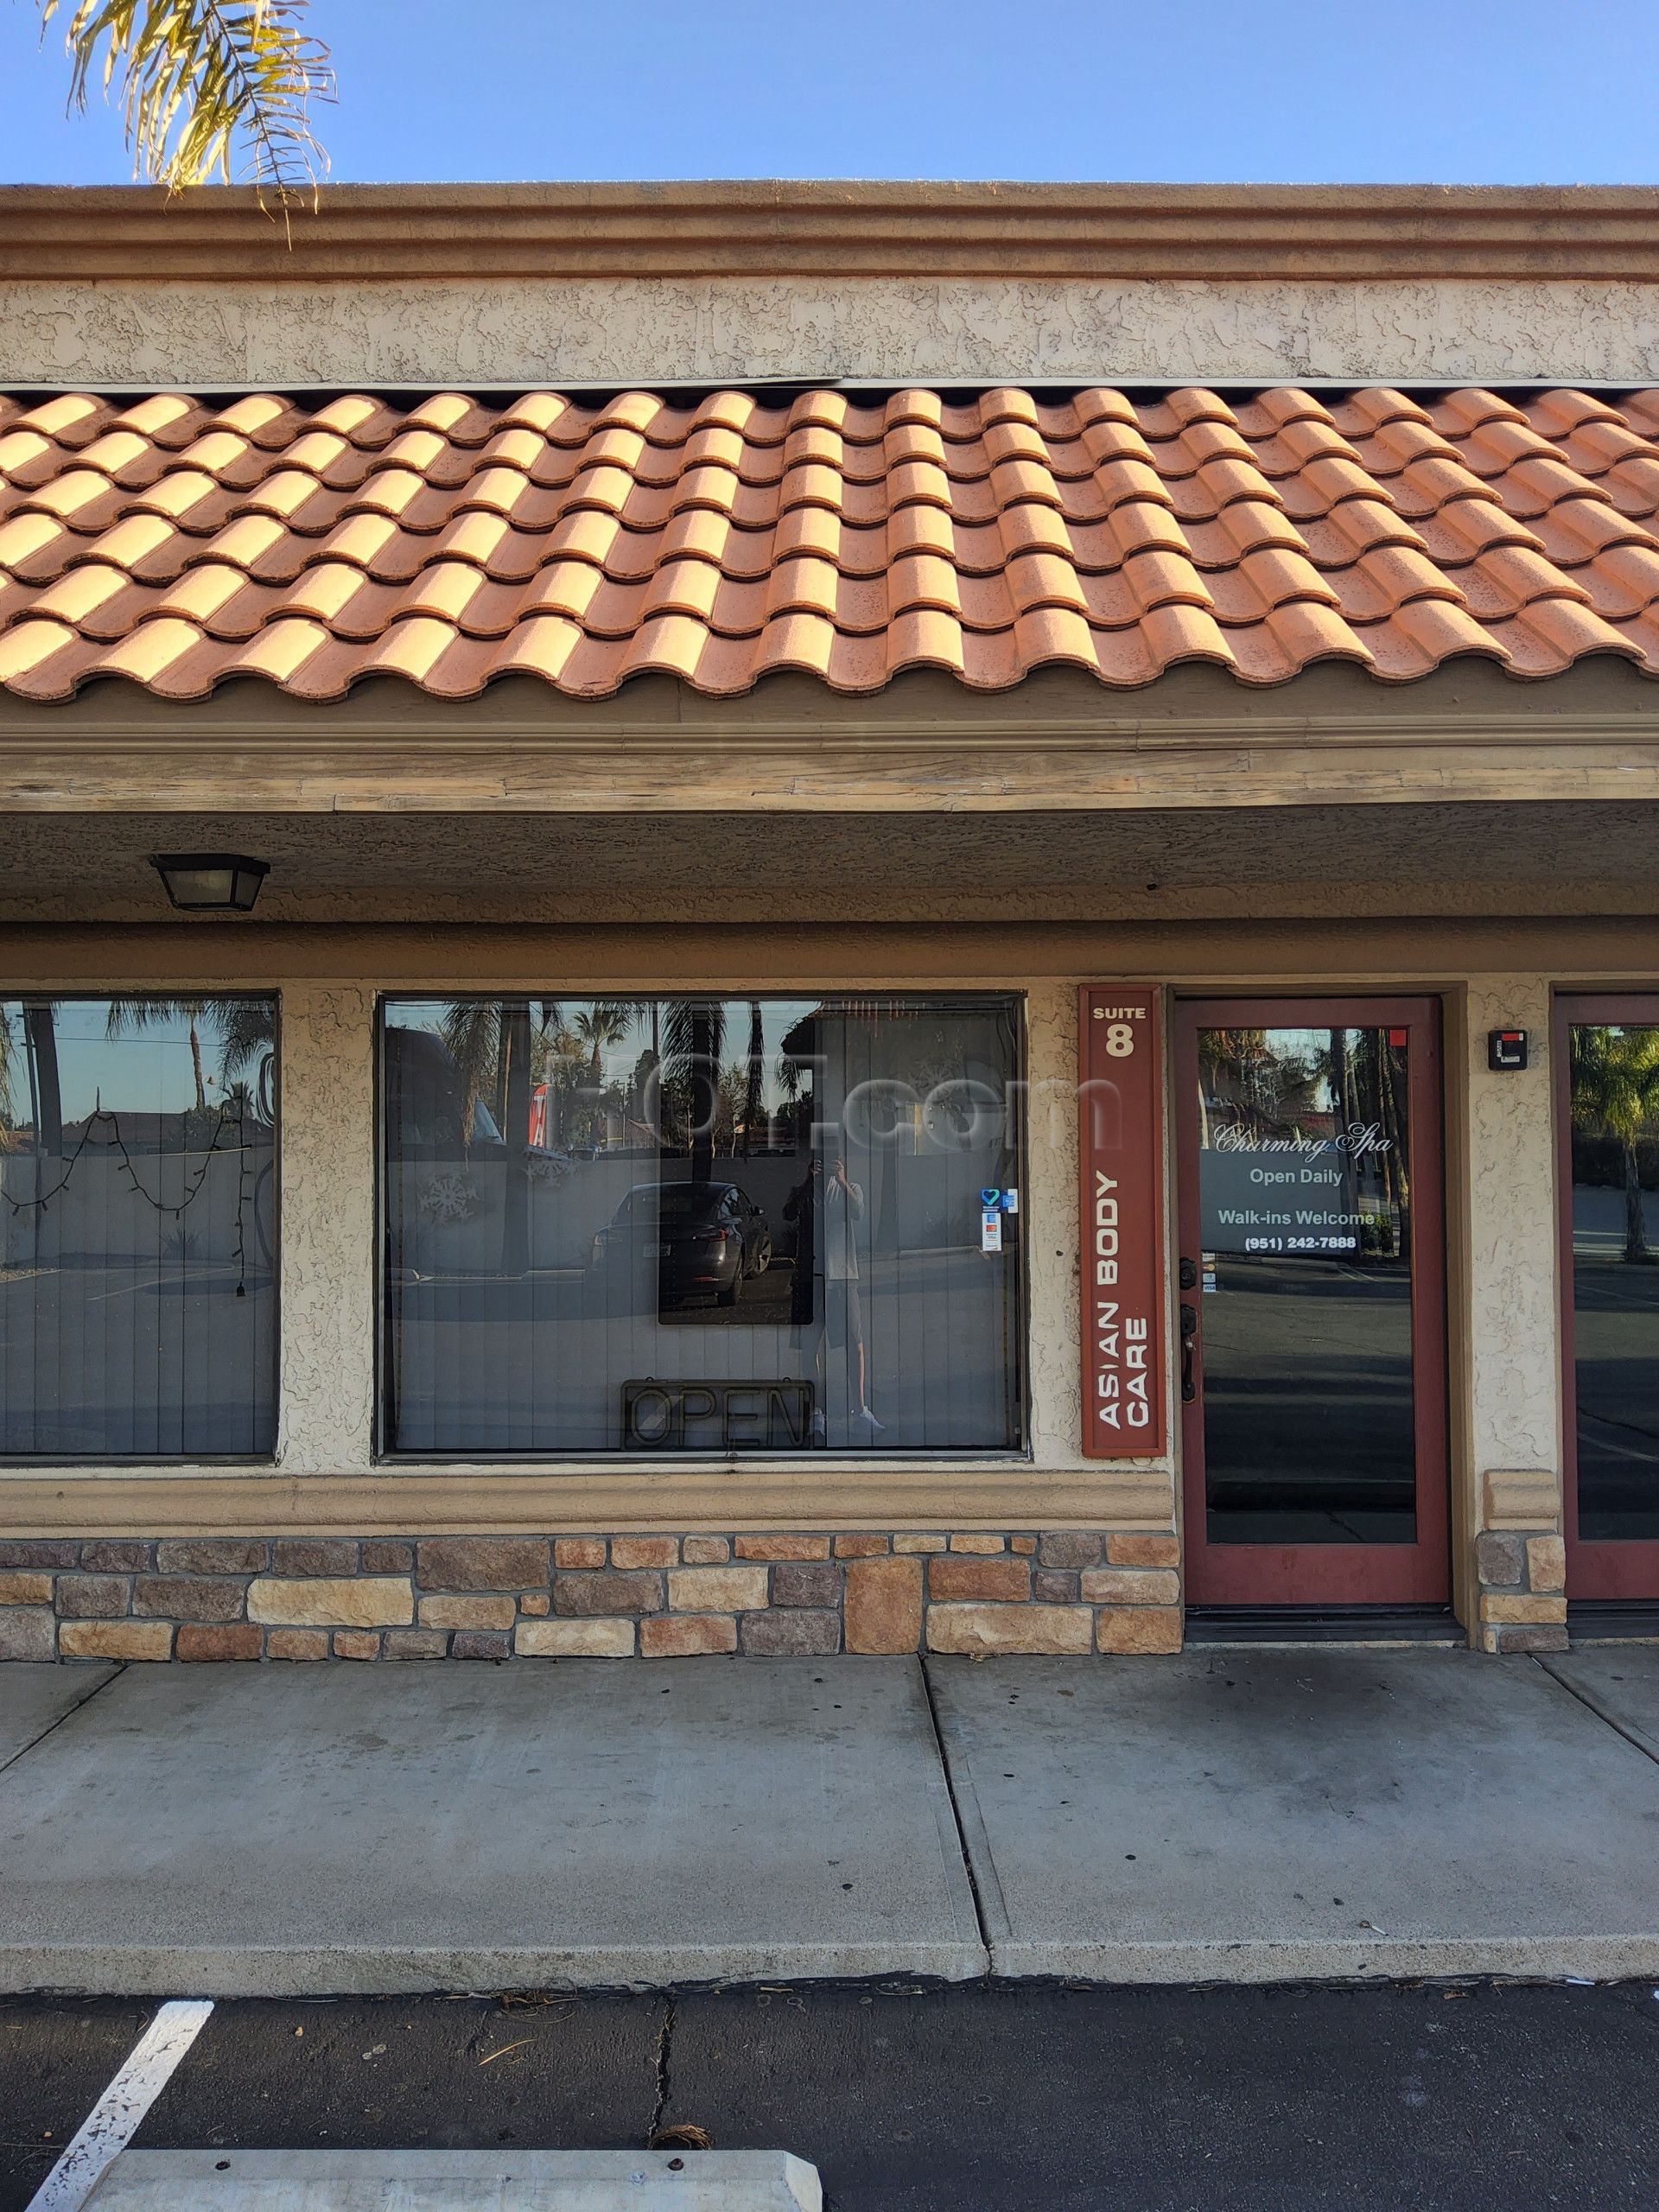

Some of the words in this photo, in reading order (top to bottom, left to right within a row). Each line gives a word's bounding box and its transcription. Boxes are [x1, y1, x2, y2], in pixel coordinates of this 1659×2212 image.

[1092, 1007, 1147, 1020] SUITE
[1106, 1023, 1135, 1058] 8
[1213, 1123, 1331, 1163] Charming
[1335, 1122, 1394, 1160] Spa
[1249, 1168, 1295, 1186] Open
[1300, 1168, 1344, 1188] Daily
[1096, 1169, 1119, 1286] BODY
[1217, 1210, 1292, 1225] Walk-ins
[1296, 1210, 1376, 1226] Welcome
[1244, 1236, 1283, 1251] (951)
[1287, 1236, 1357, 1249] 242-7888
[1096, 1301, 1122, 1430] ASIAN
[1125, 1318, 1150, 1428] CARE
[631, 1388, 805, 1447] OPEN
